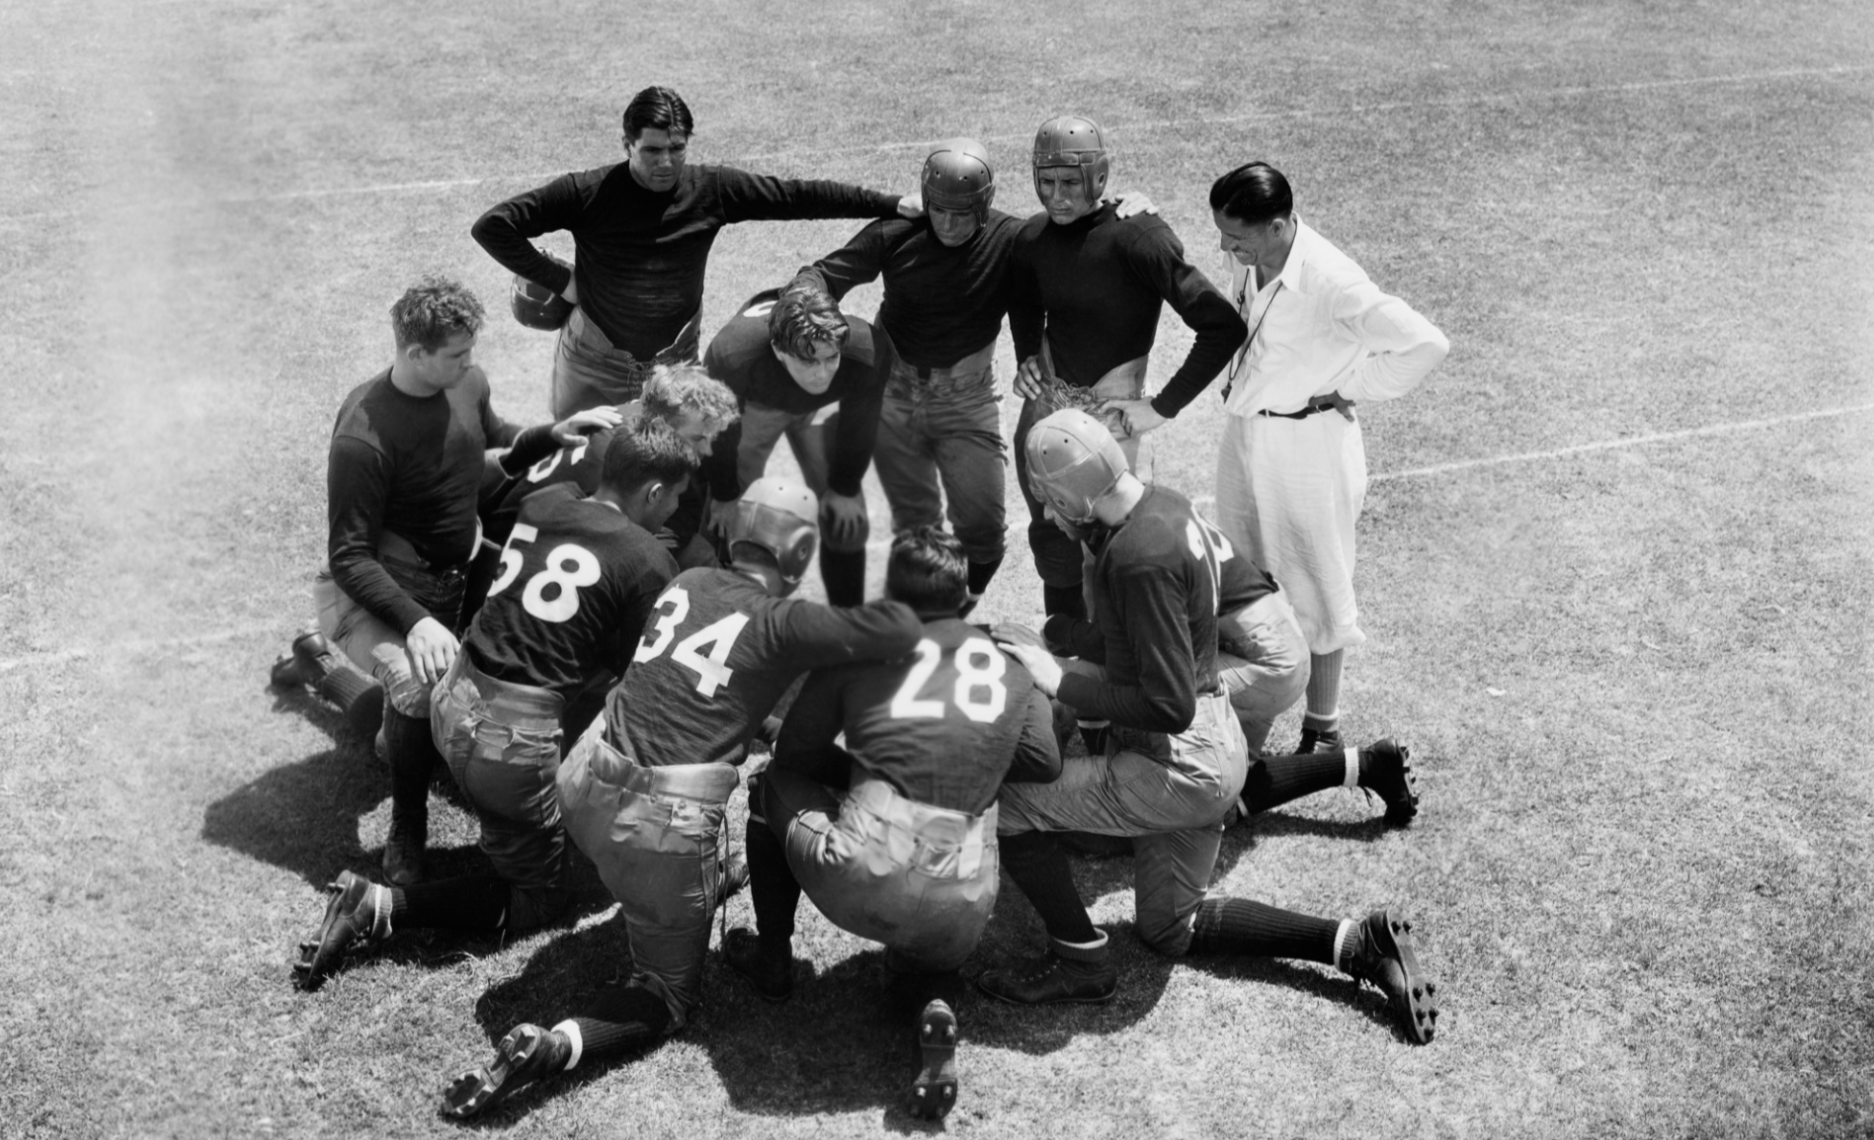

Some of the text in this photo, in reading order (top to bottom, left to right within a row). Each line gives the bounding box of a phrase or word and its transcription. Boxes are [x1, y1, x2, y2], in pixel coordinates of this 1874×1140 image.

[487, 522, 601, 623] 58
[633, 583, 749, 698] 34
[890, 637, 1007, 723] 28
